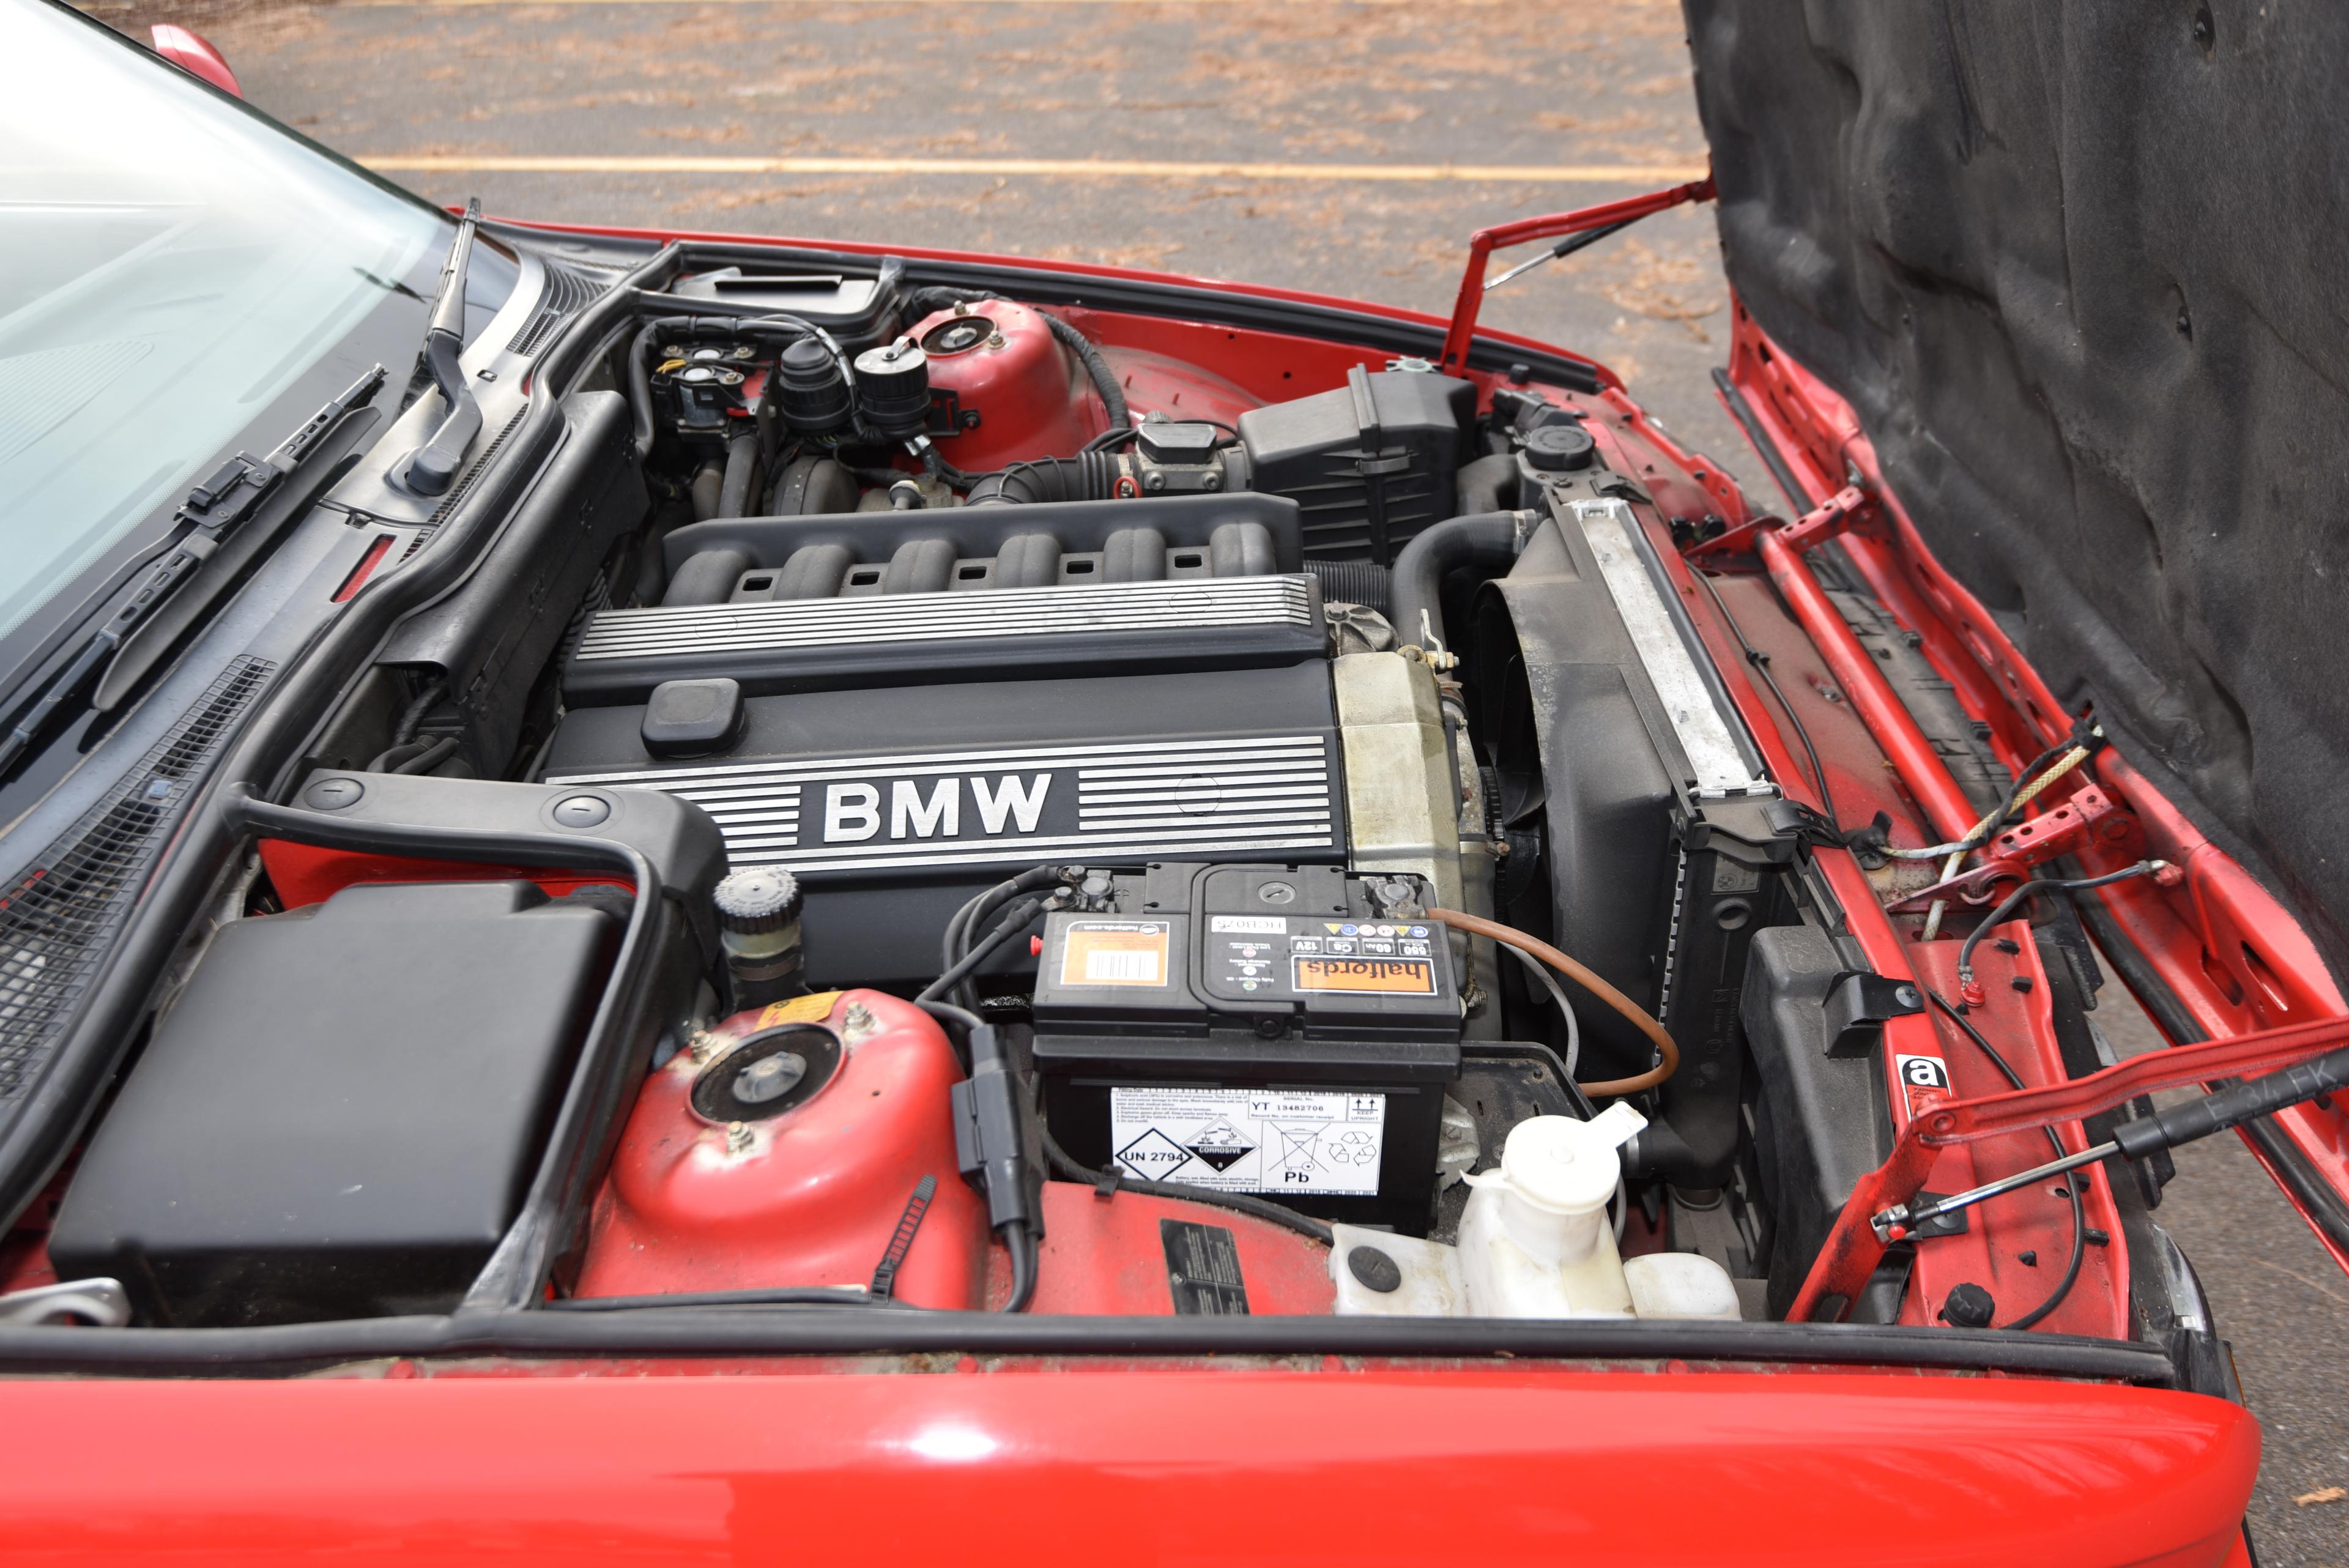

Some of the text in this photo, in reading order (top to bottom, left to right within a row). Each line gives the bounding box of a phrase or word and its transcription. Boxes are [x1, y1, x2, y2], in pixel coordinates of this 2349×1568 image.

[823, 773, 1052, 844] BMW
[1217, 921, 1281, 929] HCB075
[1296, 942, 1318, 950] 12V
[1334, 943, 1353, 953] Ca
[1404, 946, 1427, 954] 550
[1307, 961, 1422, 979] halfords
[1909, 1060, 1939, 1086] a
[1252, 1102, 1270, 1110] YT
[1124, 1152, 1184, 1161] UN 2794
[1285, 1172, 1309, 1183] Pb
